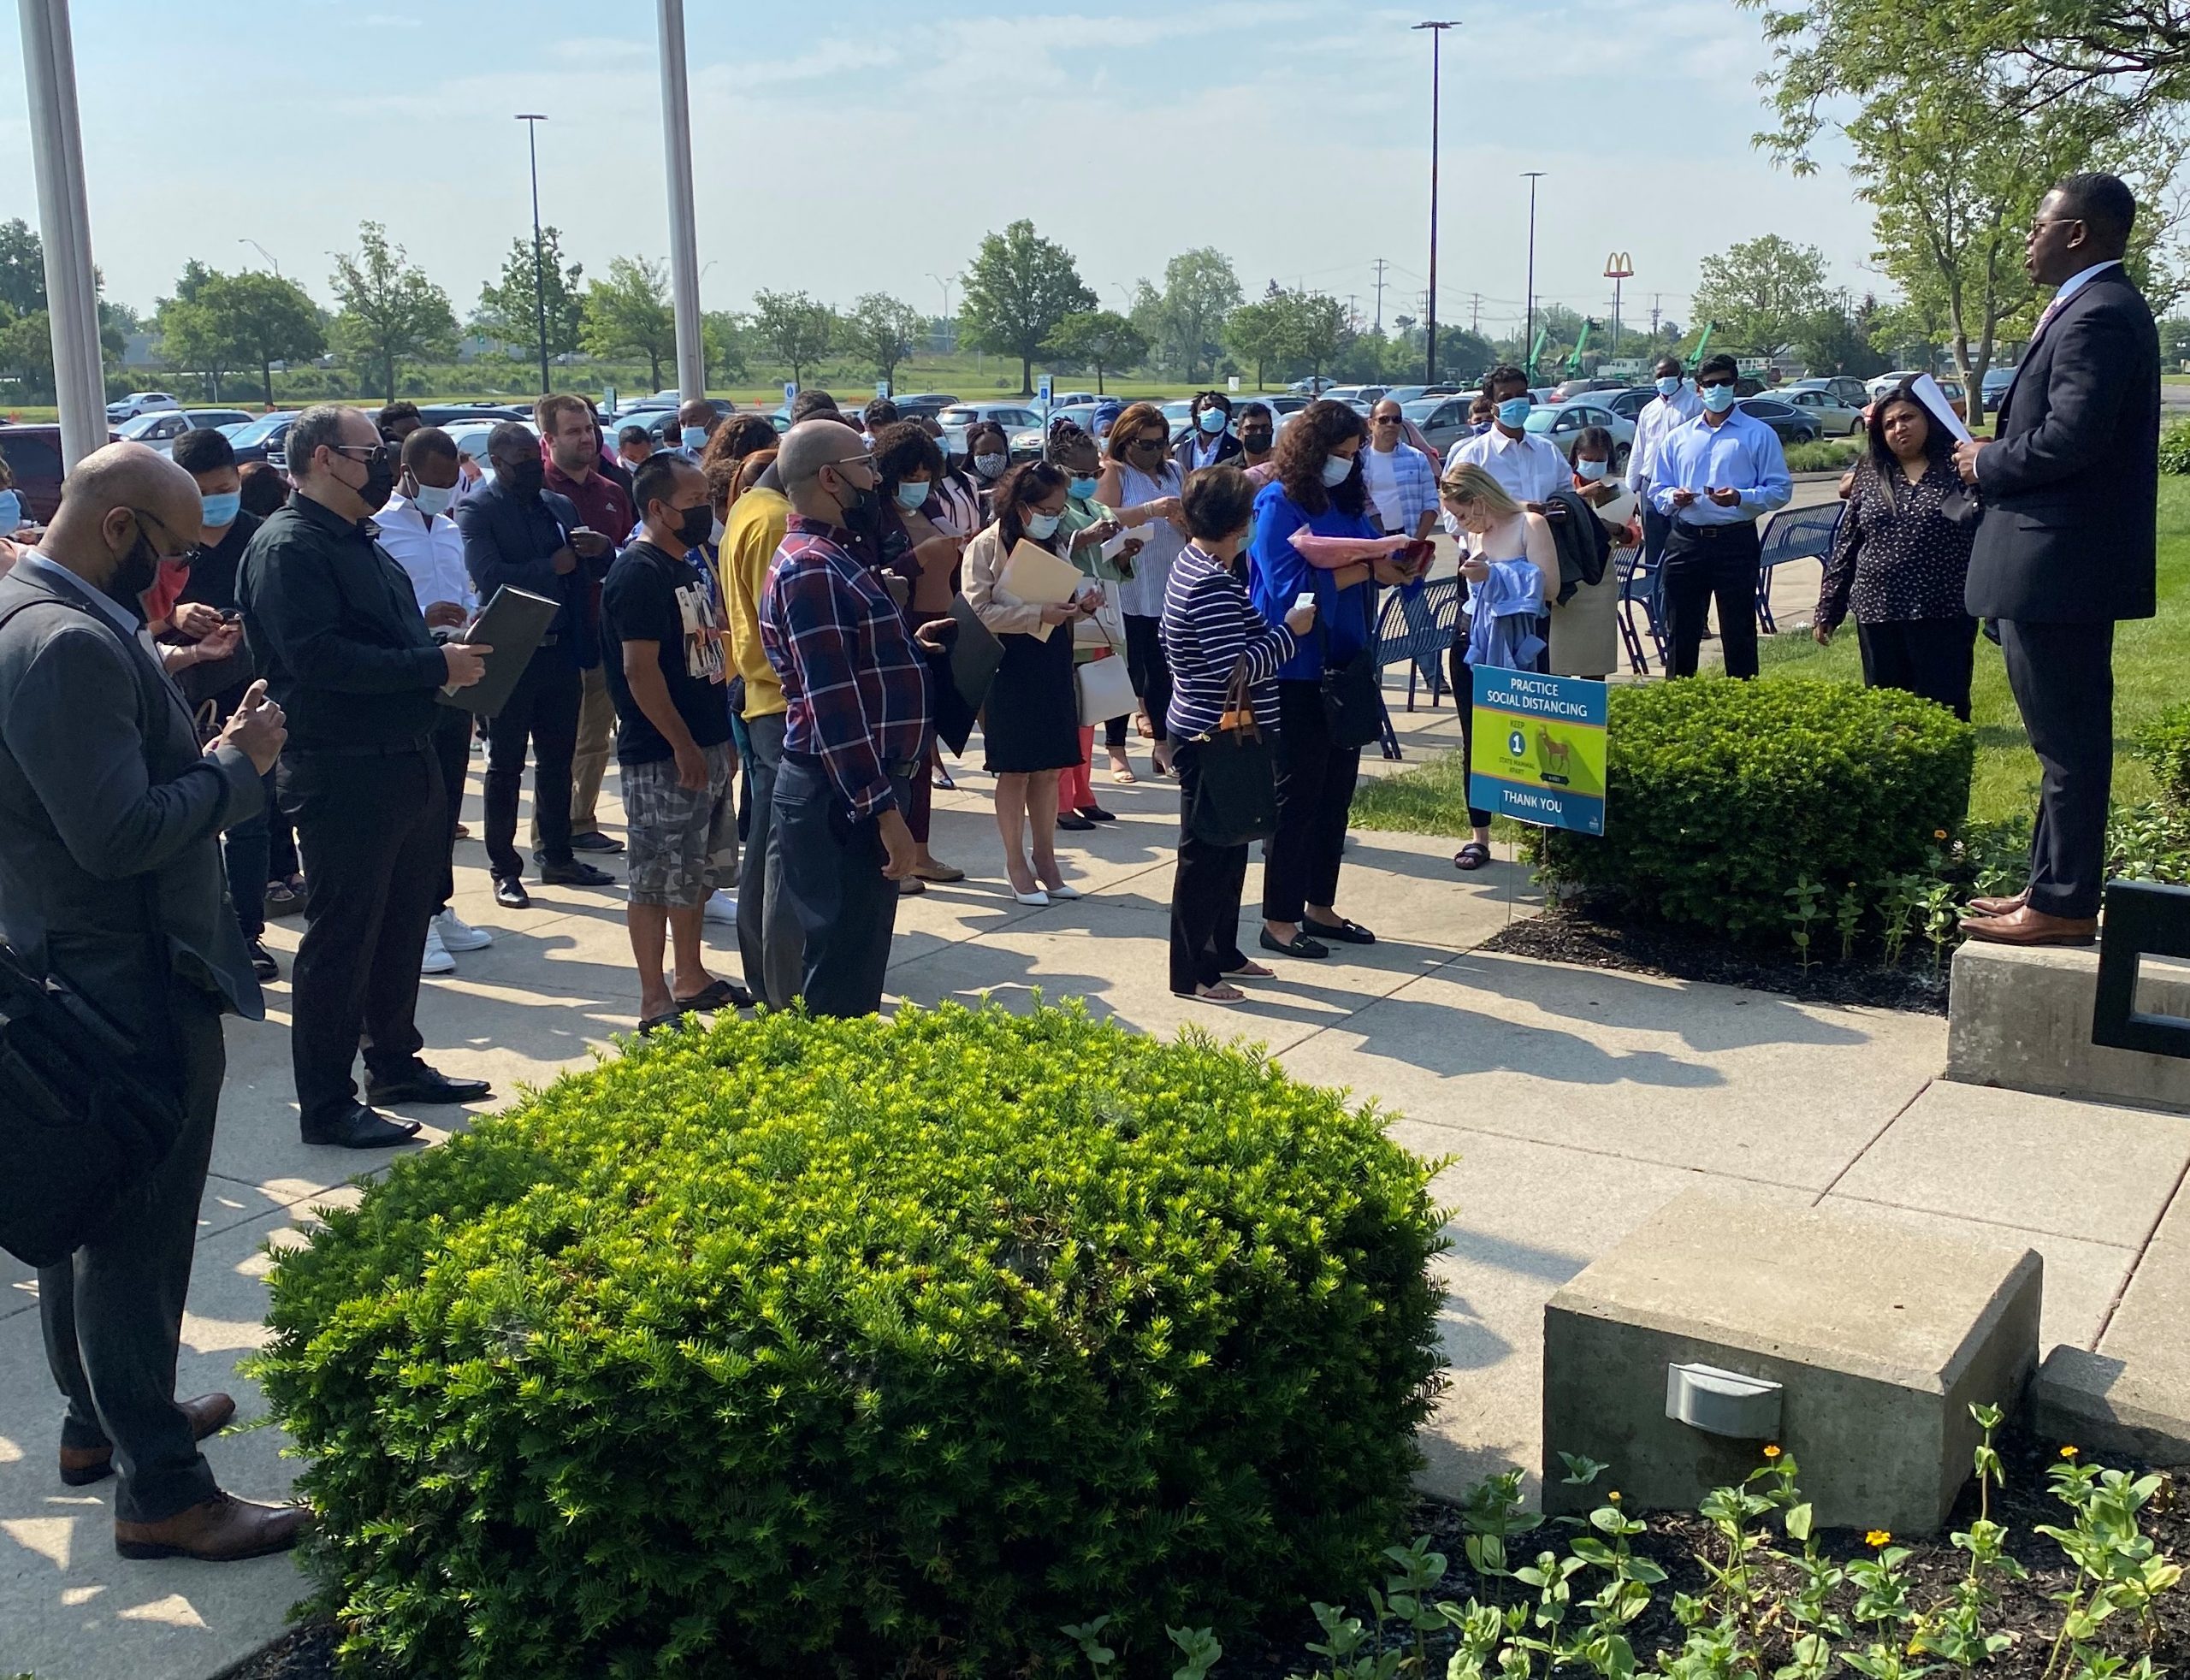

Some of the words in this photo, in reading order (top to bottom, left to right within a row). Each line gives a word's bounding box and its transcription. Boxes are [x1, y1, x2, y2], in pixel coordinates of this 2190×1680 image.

[1510, 677, 1559, 697] PRACTICE
[1487, 689, 1521, 707] SOCIAL
[1523, 695, 1588, 717] DISTANCING
[1510, 719, 1525, 730] KEEP
[1512, 735, 1522, 753] 1
[1499, 756, 1513, 766] STATE
[1513, 759, 1536, 770] MAMMAL
[1509, 766, 1524, 776] APART
[1503, 790, 1538, 808] THANK
[1540, 797, 1562, 813] YOU
